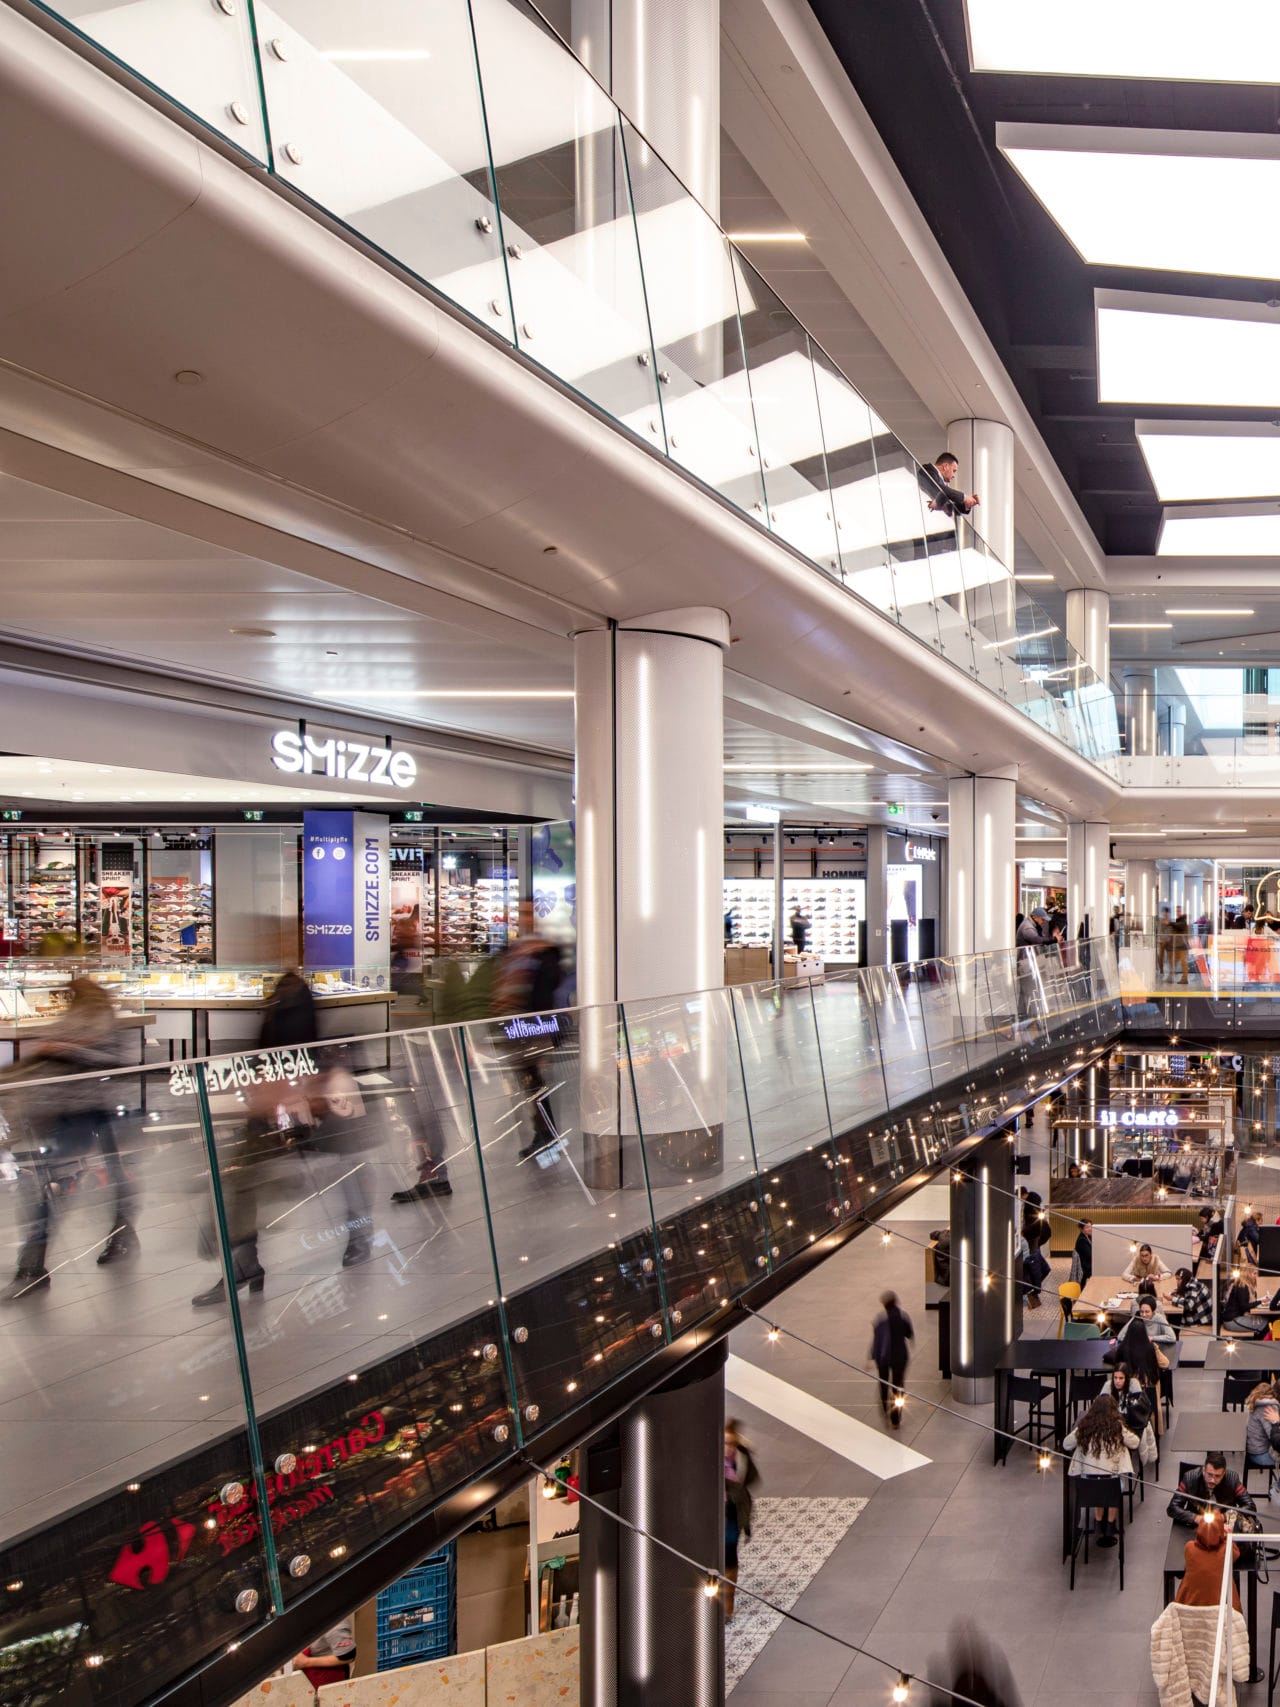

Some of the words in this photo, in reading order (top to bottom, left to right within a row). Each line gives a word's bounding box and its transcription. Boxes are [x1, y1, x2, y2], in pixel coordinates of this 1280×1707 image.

[822, 870, 865, 879] HOMME
[365, 838, 380, 942] SMIZZE.COM
[1100, 1110, 1117, 1126] il
